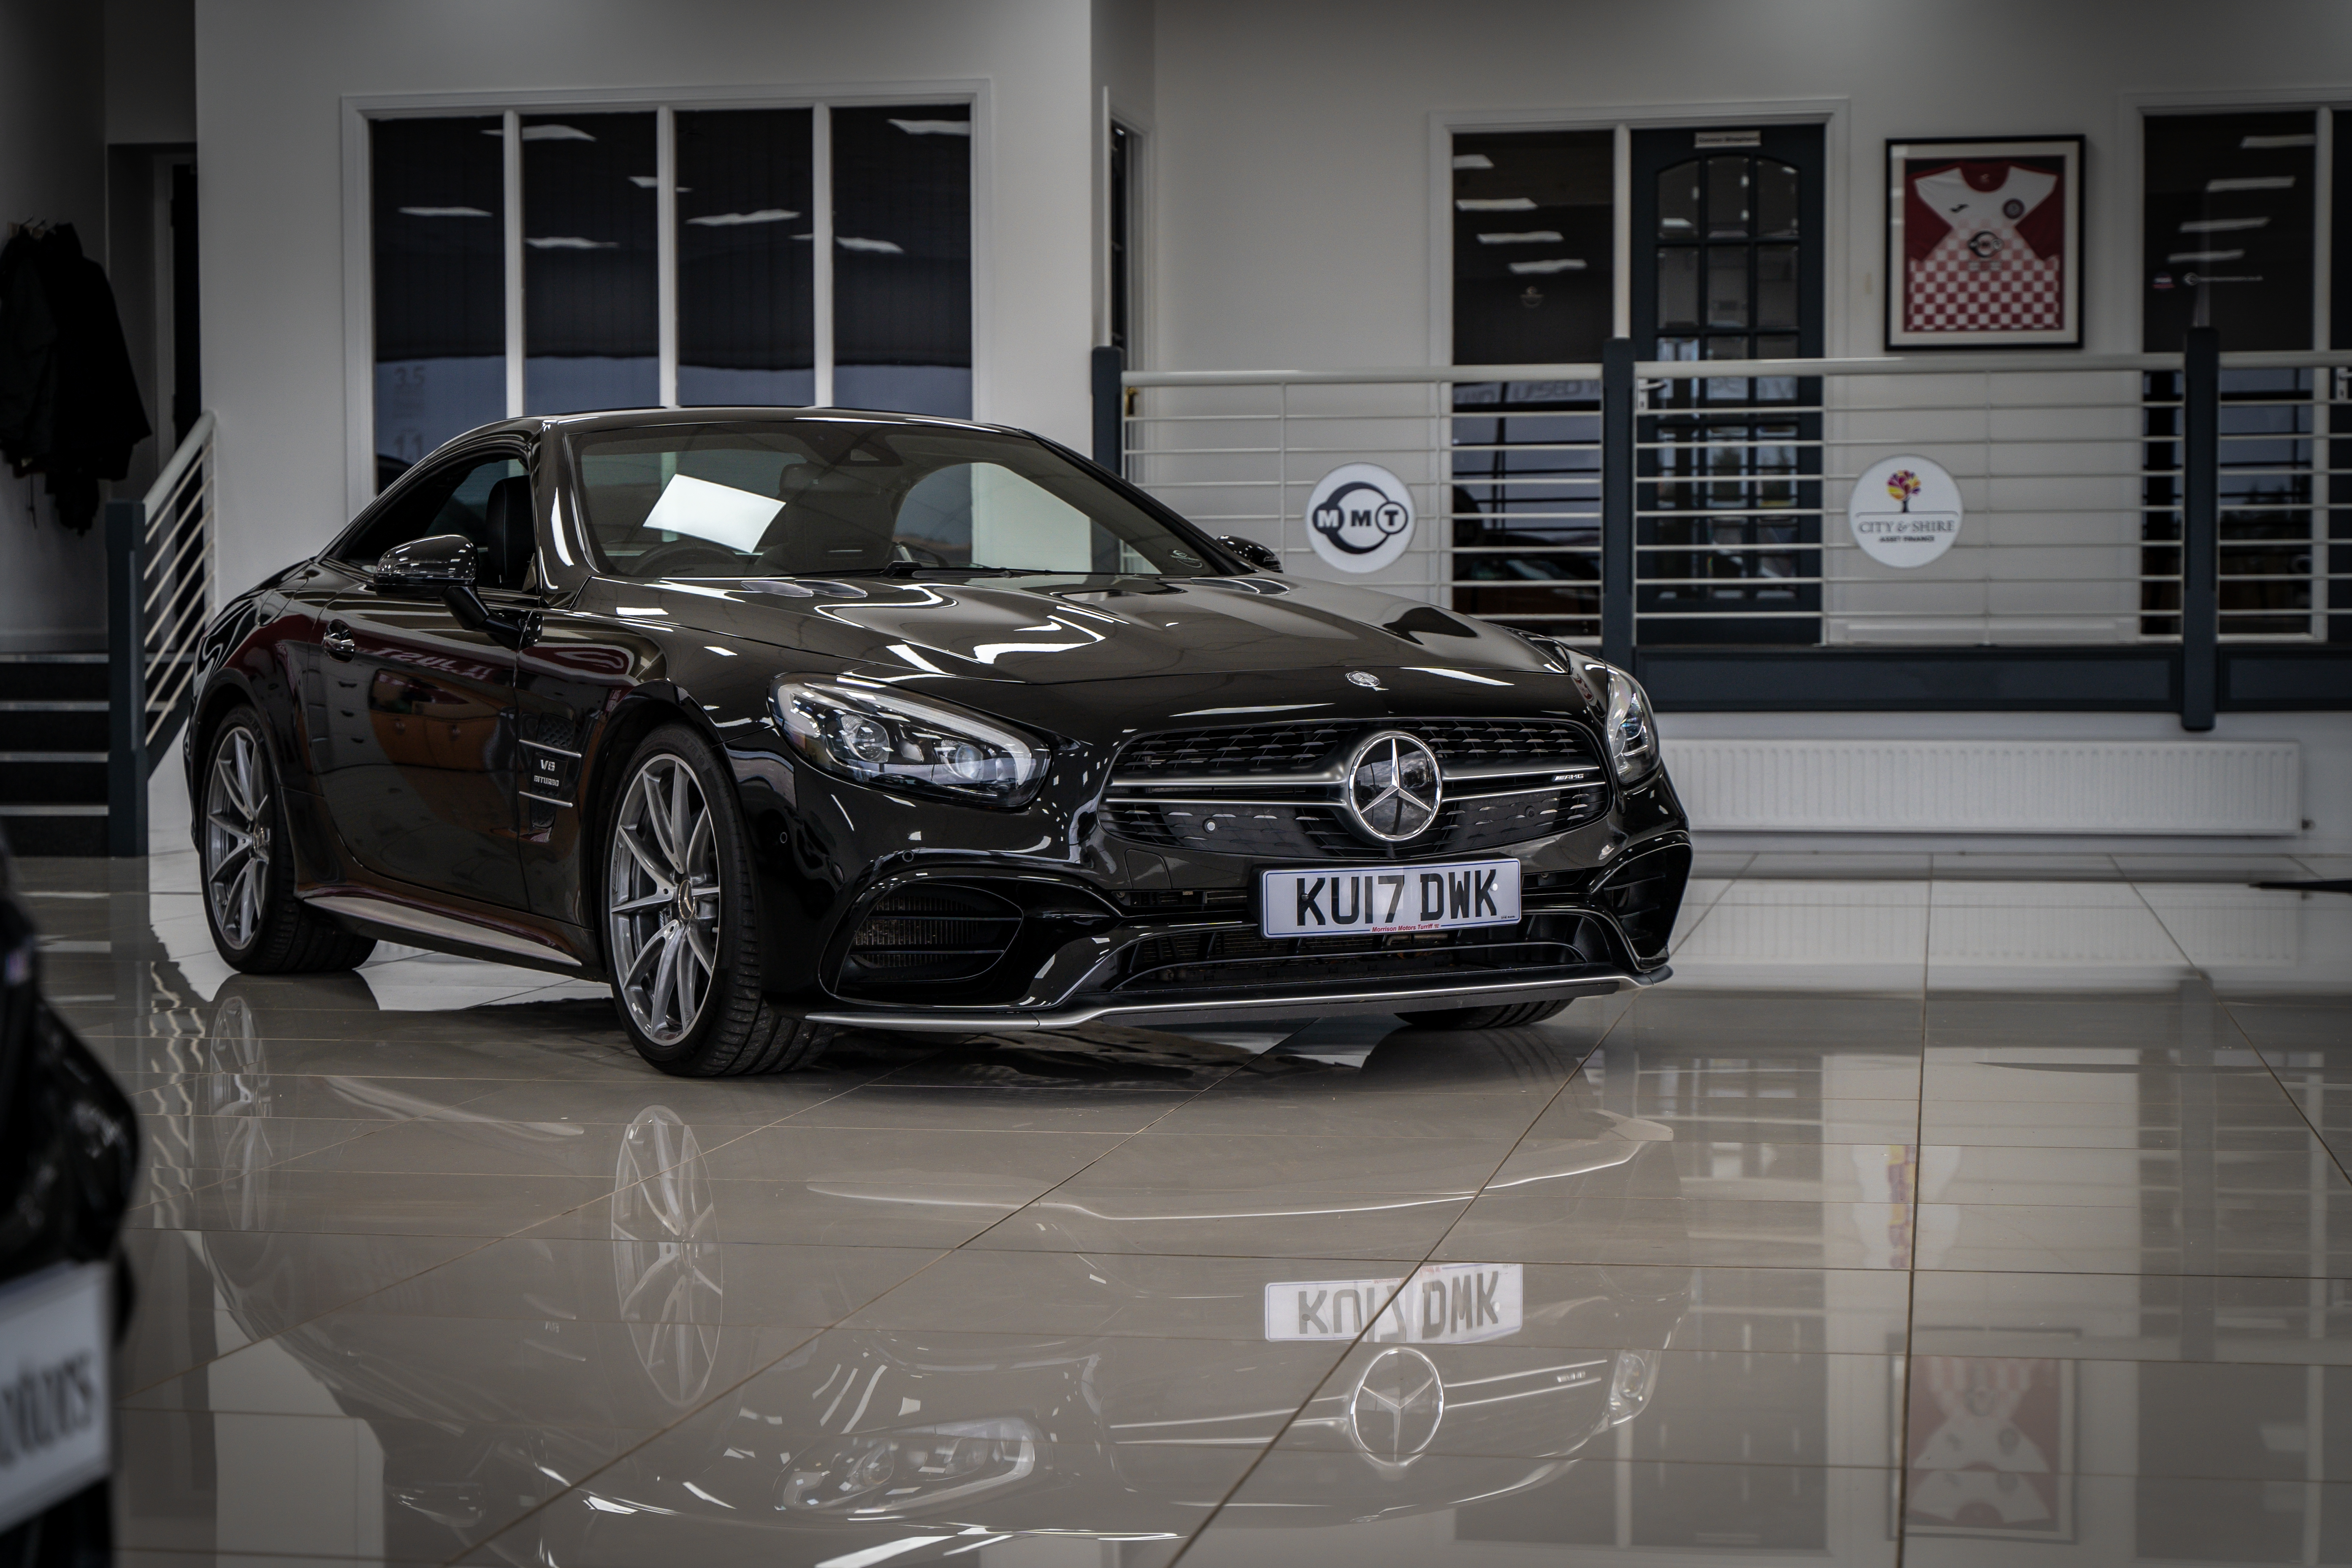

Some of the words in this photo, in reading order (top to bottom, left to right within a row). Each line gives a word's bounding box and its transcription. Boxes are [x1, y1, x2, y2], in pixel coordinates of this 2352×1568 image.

[1317, 509, 1398, 528] MMT
[1859, 521, 1894, 533] CITY
[1897, 521, 1909, 532] &
[1912, 520, 1955, 532] SHIRE
[540, 759, 555, 772] V8
[534, 775, 559, 787] BITURBO
[1297, 875, 1404, 926] KU17
[1420, 869, 1497, 921] DWK
